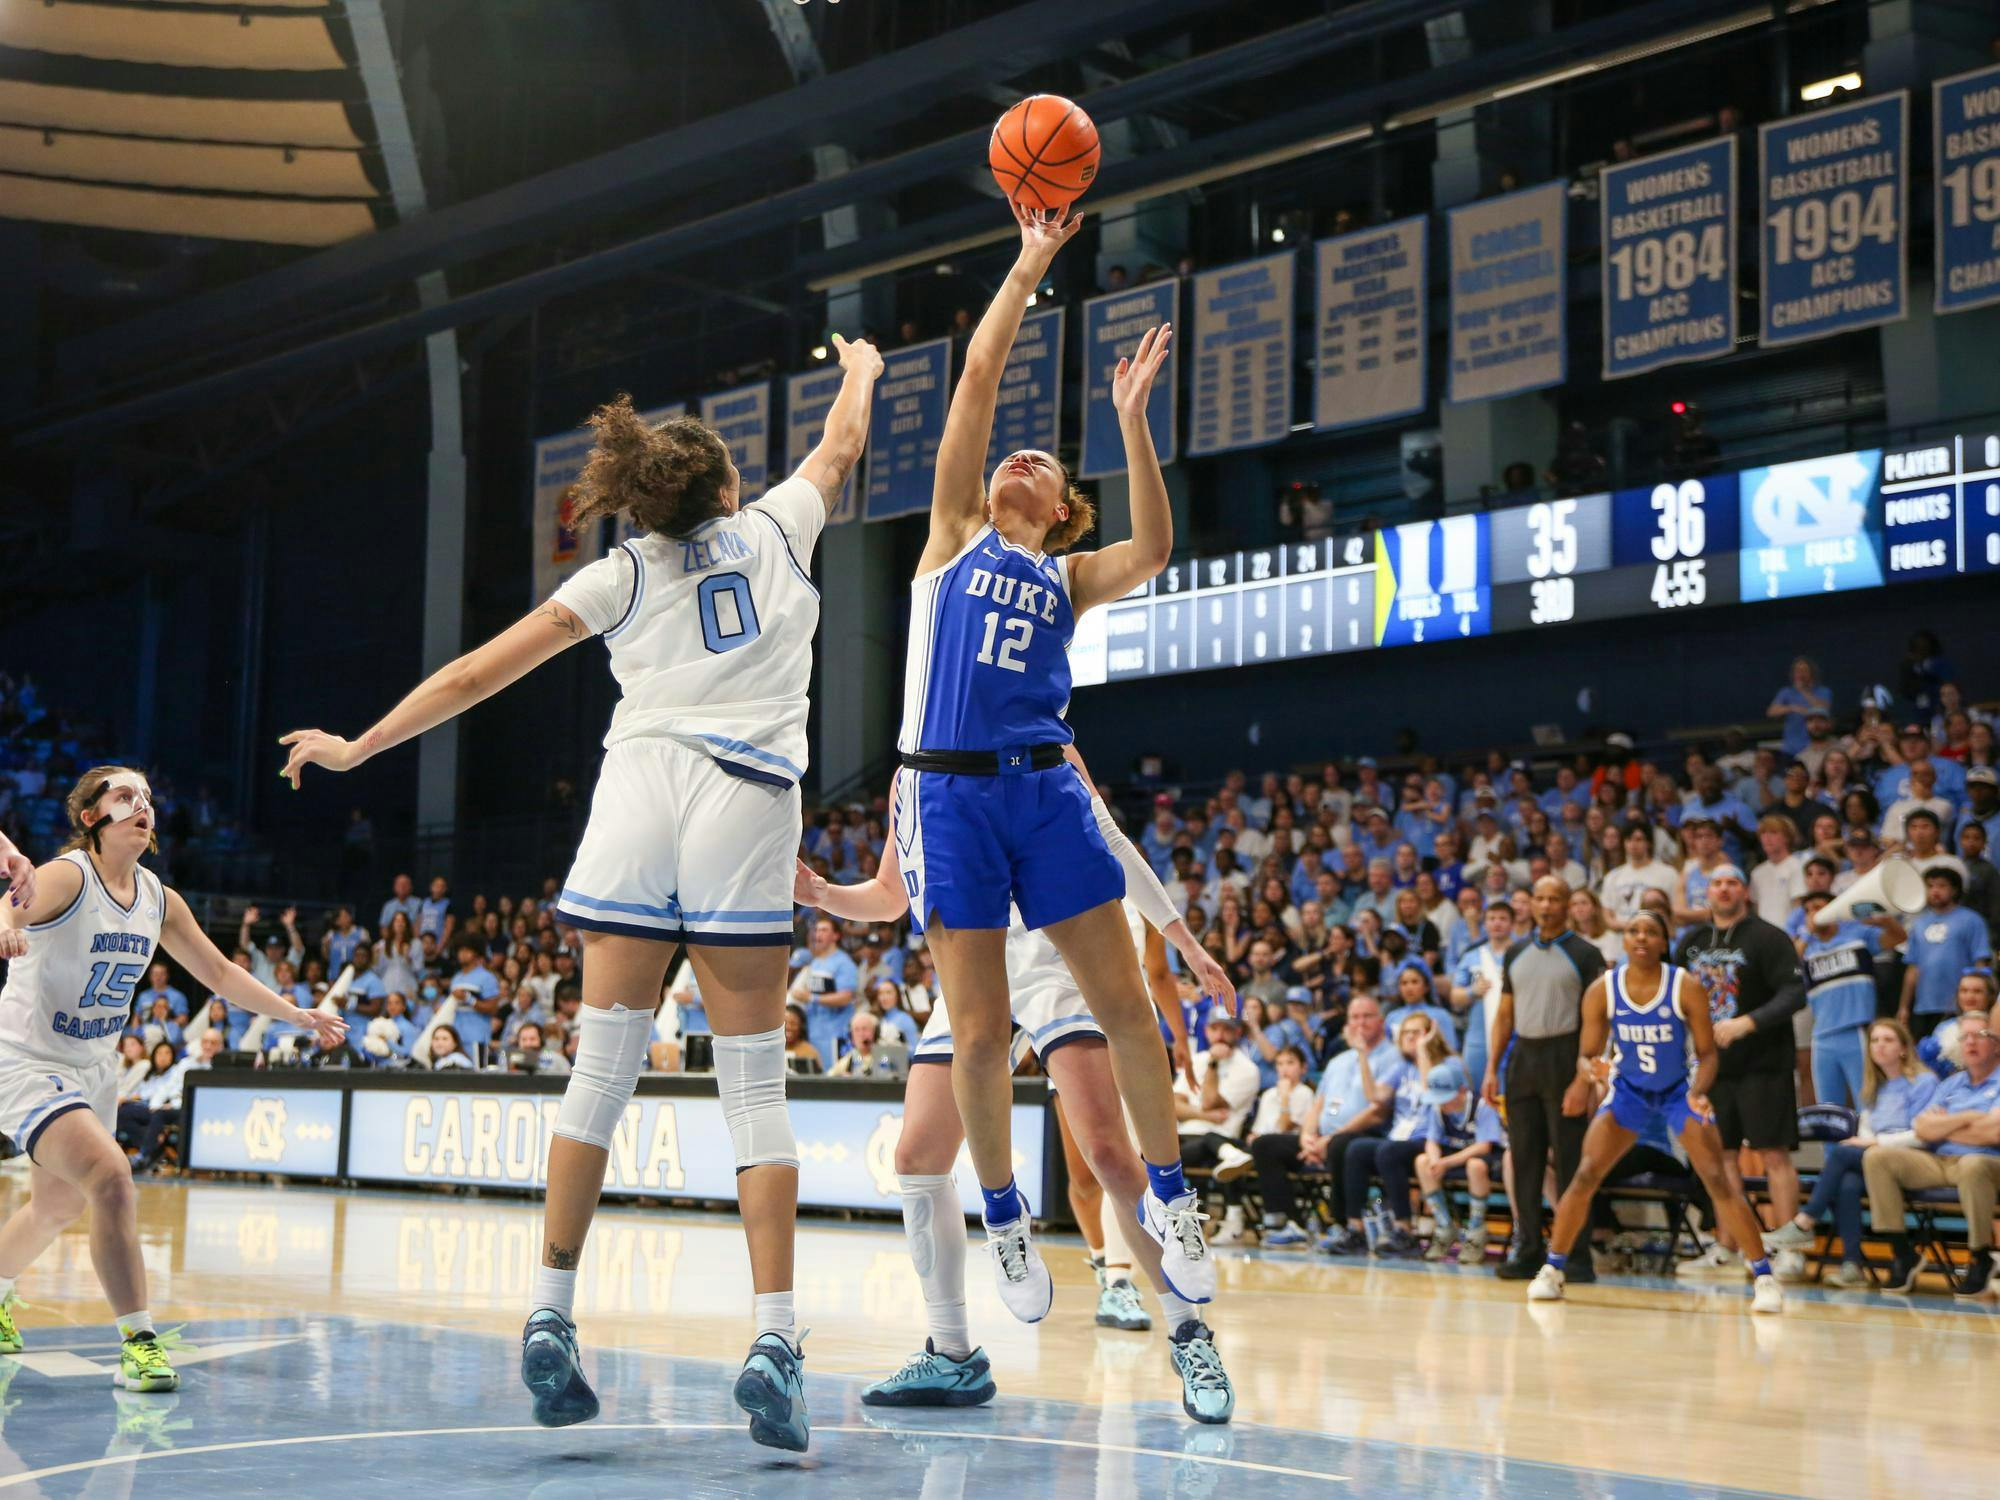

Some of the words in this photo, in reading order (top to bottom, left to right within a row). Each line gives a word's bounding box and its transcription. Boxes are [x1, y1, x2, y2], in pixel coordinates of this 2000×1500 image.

[1770, 151, 1894, 200] BASKETBALL
[1611, 193, 1724, 240] BASKETBALL
[1768, 183, 1897, 265] 1994
[1610, 224, 1726, 301] 1984
[1811, 255, 1855, 288] ACC
[1649, 291, 1689, 322] ACC
[1772, 280, 1893, 328] CHAMPIONS
[1615, 314, 1726, 361] CHAMPIONS
[1884, 446, 1949, 481] PLAYER
[1651, 479, 1705, 561] 36
[1885, 492, 1951, 527] POINTS
[1527, 499, 1577, 578] 35
[1804, 538, 1857, 567] FOULS
[1890, 538, 1946, 572] FOULS
[1169, 567, 1179, 592] 5
[1210, 560, 1226, 585] 12
[1252, 553, 1270, 579] 22
[1298, 545, 1316, 572] 24
[1345, 537, 1363, 564] 42
[1651, 559, 1706, 609] 4:55
[1823, 566, 1835, 591] 2
[697, 571, 761, 654] 0
[966, 568, 1058, 624] DUKE
[1168, 605, 1179, 631] 7
[1530, 577, 1574, 624] 3RD
[977, 612, 1034, 673] 12
[1168, 644, 1178, 668] 1
[1212, 637, 1221, 663] 1
[1254, 631, 1267, 657] 0
[1300, 625, 1312, 651] 2
[1349, 619, 1359, 645] 1
[1413, 618, 1424, 642] 2
[90, 932, 151, 957] NORTH
[79, 961, 145, 1008] 15
[1617, 1023, 1674, 1043] DUKE
[1636, 1044, 1657, 1074] 5
